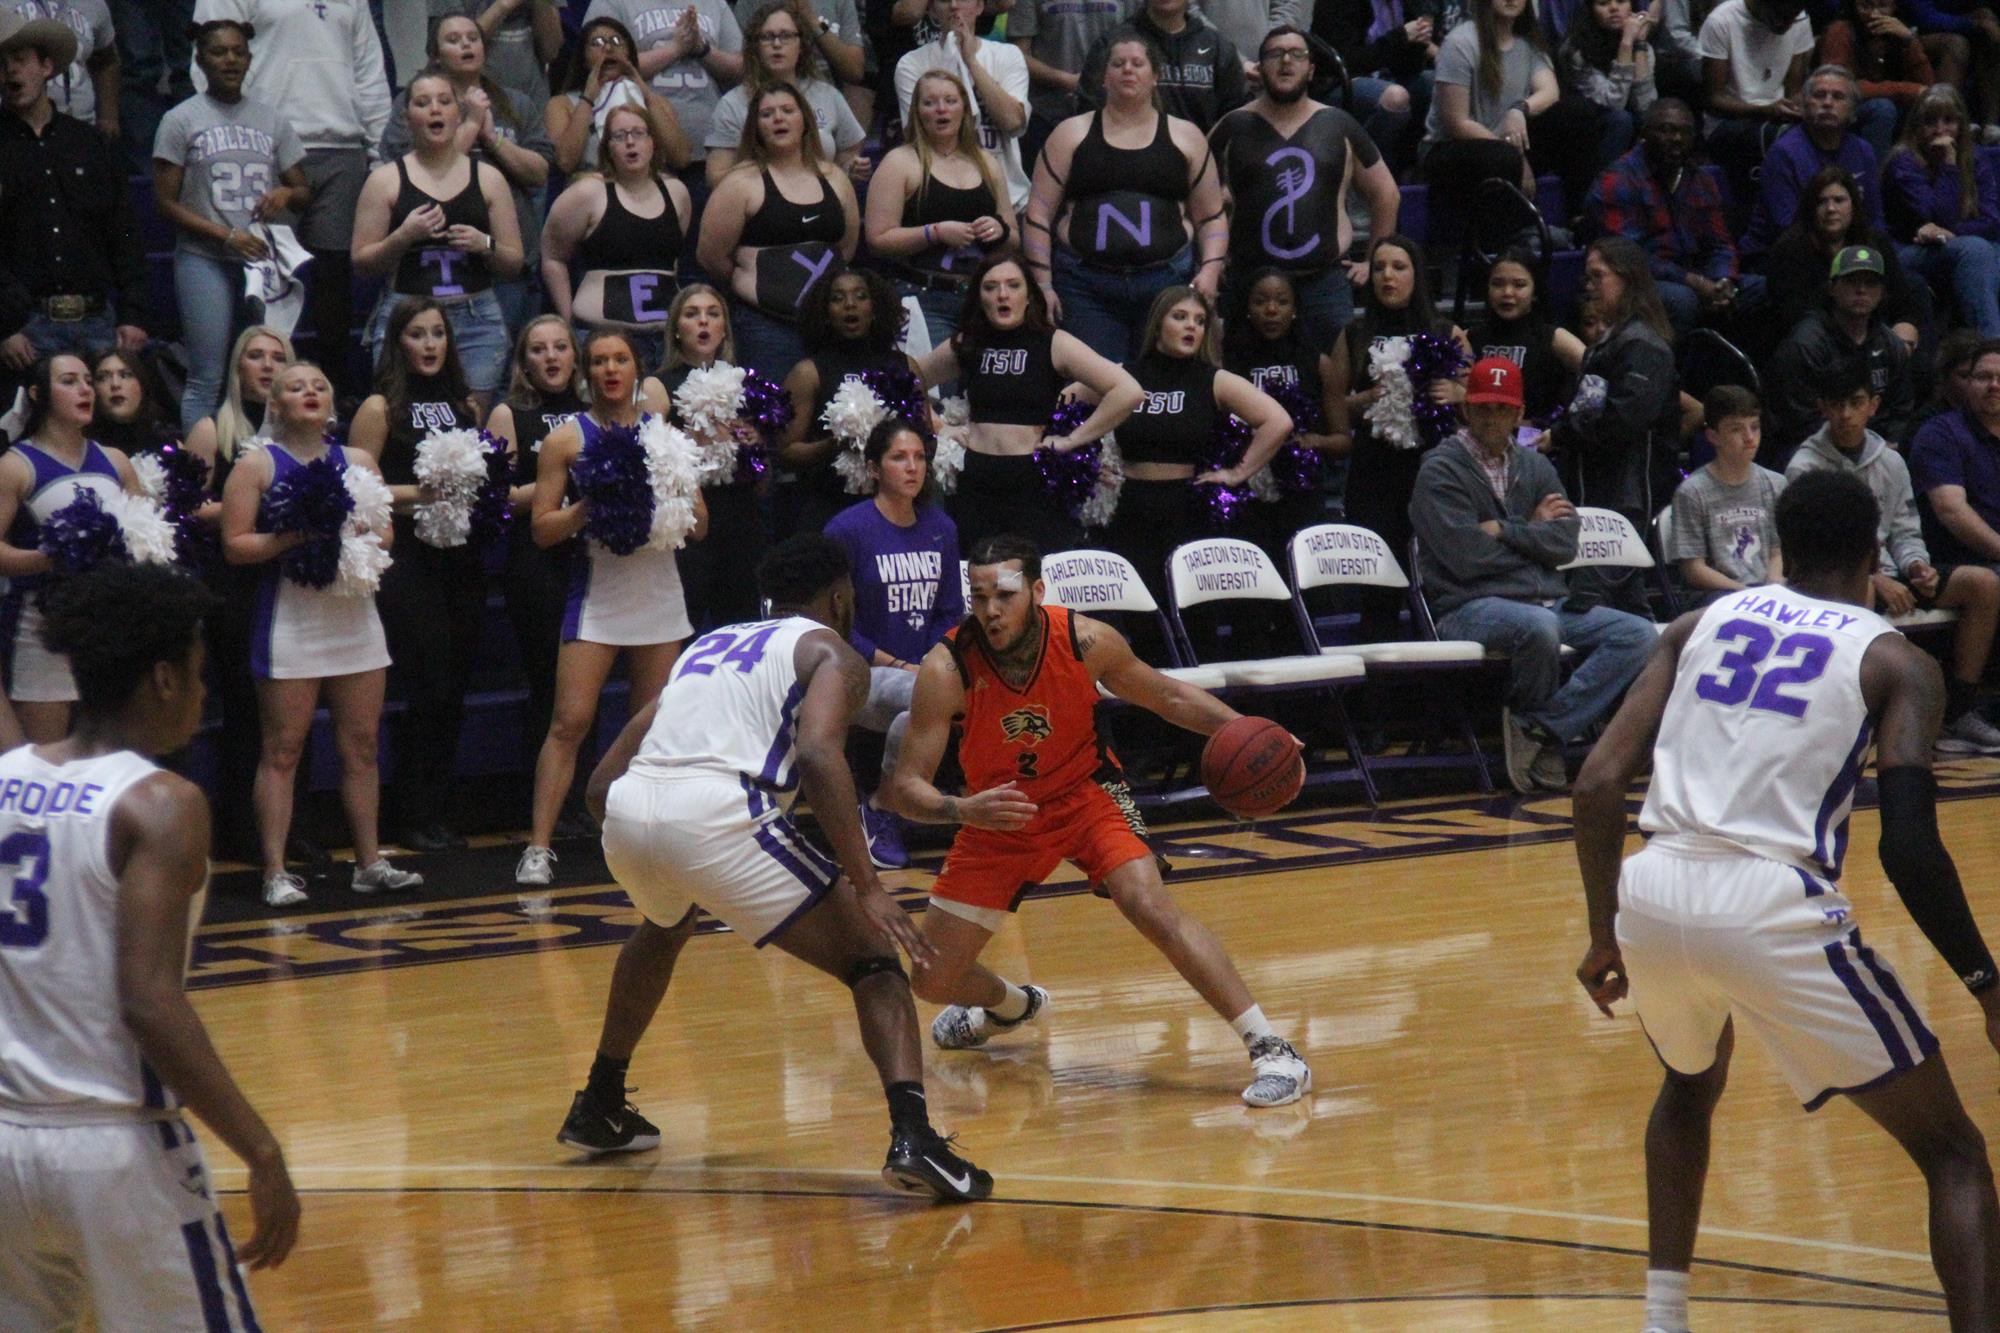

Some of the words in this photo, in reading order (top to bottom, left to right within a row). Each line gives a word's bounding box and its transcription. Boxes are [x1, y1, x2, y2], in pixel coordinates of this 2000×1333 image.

[194, 125, 274, 160] TARLETO
[211, 162, 268, 211] 23
[1096, 200, 1151, 250] N
[420, 250, 469, 296] T
[629, 274, 669, 322] E
[980, 348, 1028, 375] TSU
[1490, 368, 1507, 386] T
[411, 402, 456, 428] TSU
[1595, 515, 1628, 538] STATE
[1305, 531, 1350, 557] TARLETON
[1351, 533, 1383, 557] STATE
[876, 550, 942, 583] WINNER
[1045, 557, 1095, 584] TARLETON
[1094, 557, 1129, 582] STATE
[1182, 546, 1229, 573] TARLETON
[1229, 546, 1263, 569] STATE
[1316, 557, 1379, 576] UNIVERSITY
[1057, 583, 1124, 604] UNIVERSITY
[1195, 570, 1259, 591] UNIVERSITY
[887, 581, 939, 613] STAYS
[1733, 595, 1858, 631] HAWLEY
[675, 626, 782, 681] 24
[1695, 618, 1835, 719] 32
[1017, 751, 1039, 777] 2
[0, 778, 105, 816] RODE
